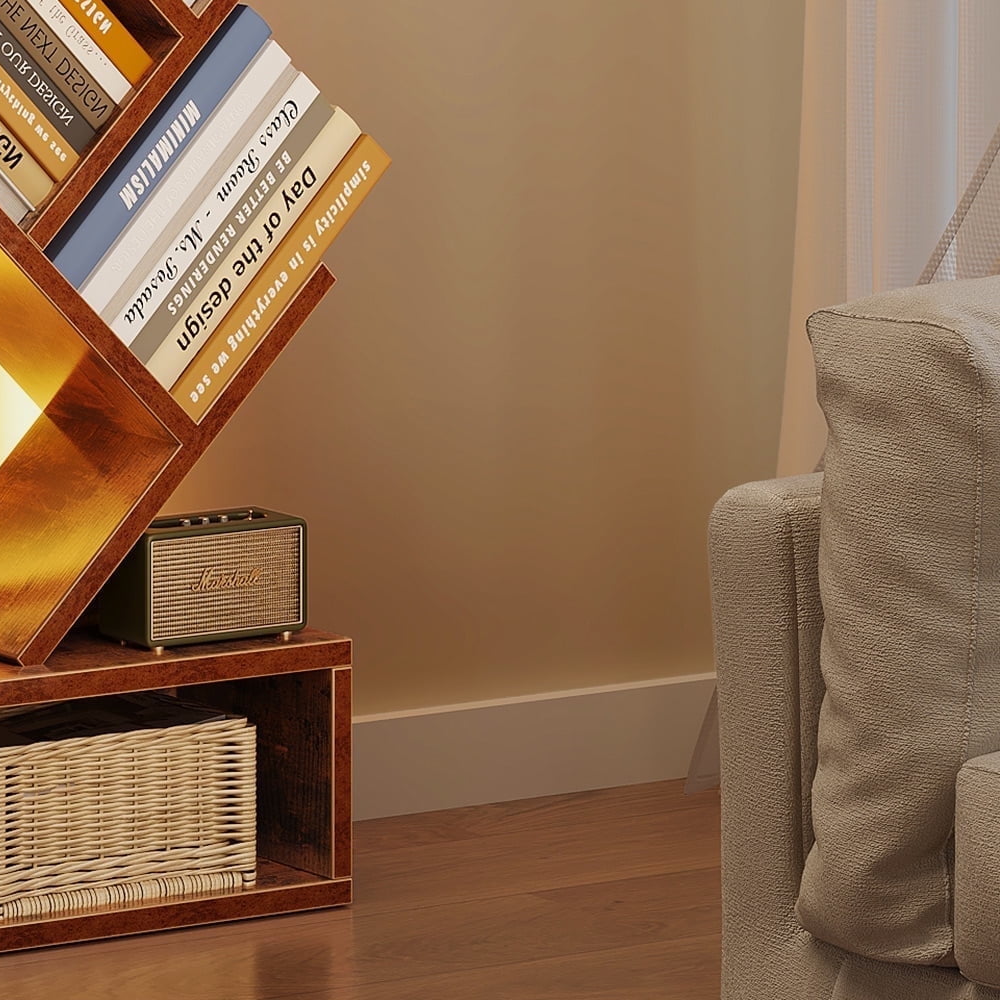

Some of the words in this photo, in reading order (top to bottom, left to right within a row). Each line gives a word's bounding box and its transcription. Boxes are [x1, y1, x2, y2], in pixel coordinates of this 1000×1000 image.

[259, 100, 298, 146] Class
[118, 99, 201, 210] MINIMALISM
[216, 148, 260, 202] Room
[275, 150, 292, 173] BE
[234, 171, 276, 224] BETTER
[281, 165, 317, 212] Day
[315, 160, 370, 236] simplicity
[174, 219, 203, 251] Ms.
[262, 212, 281, 244] of
[302, 234, 317, 252] is
[167, 223, 236, 315] RENDERINGS
[232, 238, 263, 276] the
[288, 251, 304, 270] in
[123, 256, 178, 324] Posada
[227, 271, 288, 352] everything
[176, 277, 231, 351] design
[211, 351, 229, 374] we
[189, 374, 211, 403] see
[191, 567, 262, 593] Marshall
